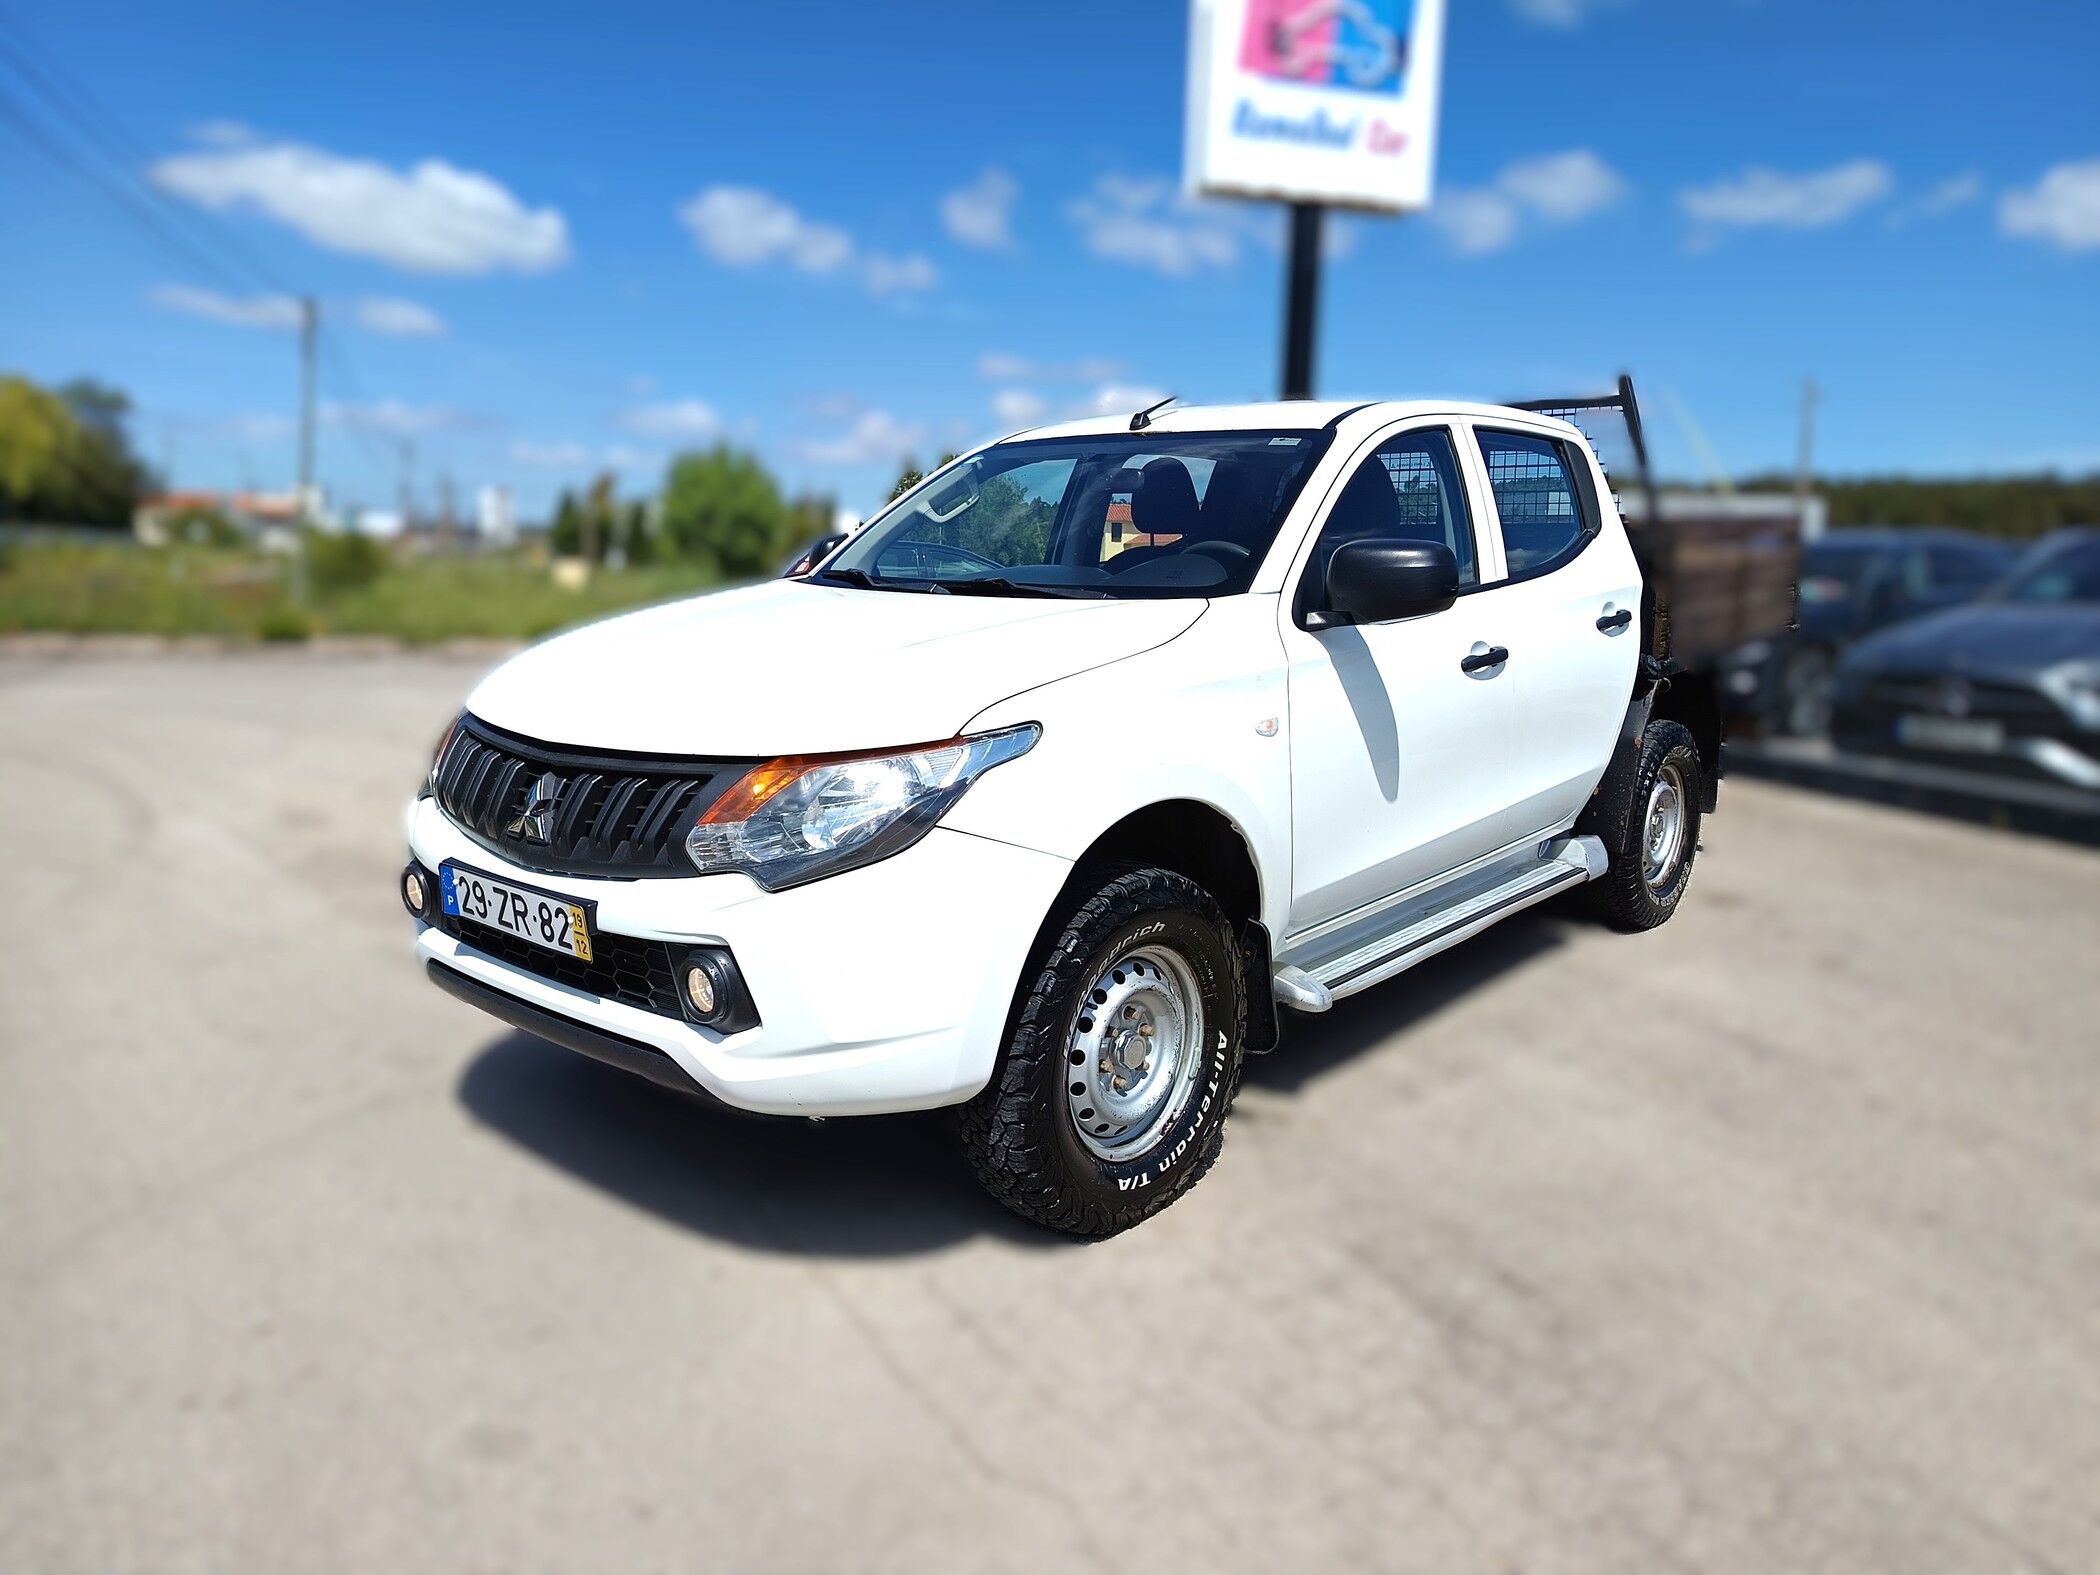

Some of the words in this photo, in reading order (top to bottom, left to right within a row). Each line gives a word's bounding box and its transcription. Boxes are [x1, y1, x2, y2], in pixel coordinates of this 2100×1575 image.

[448, 895, 454, 906] P
[572, 912, 583, 929] 19
[576, 939, 589, 955] 12
[1158, 1030, 1228, 1173] All-Terrain
[1117, 1172, 1151, 1191] T/A
